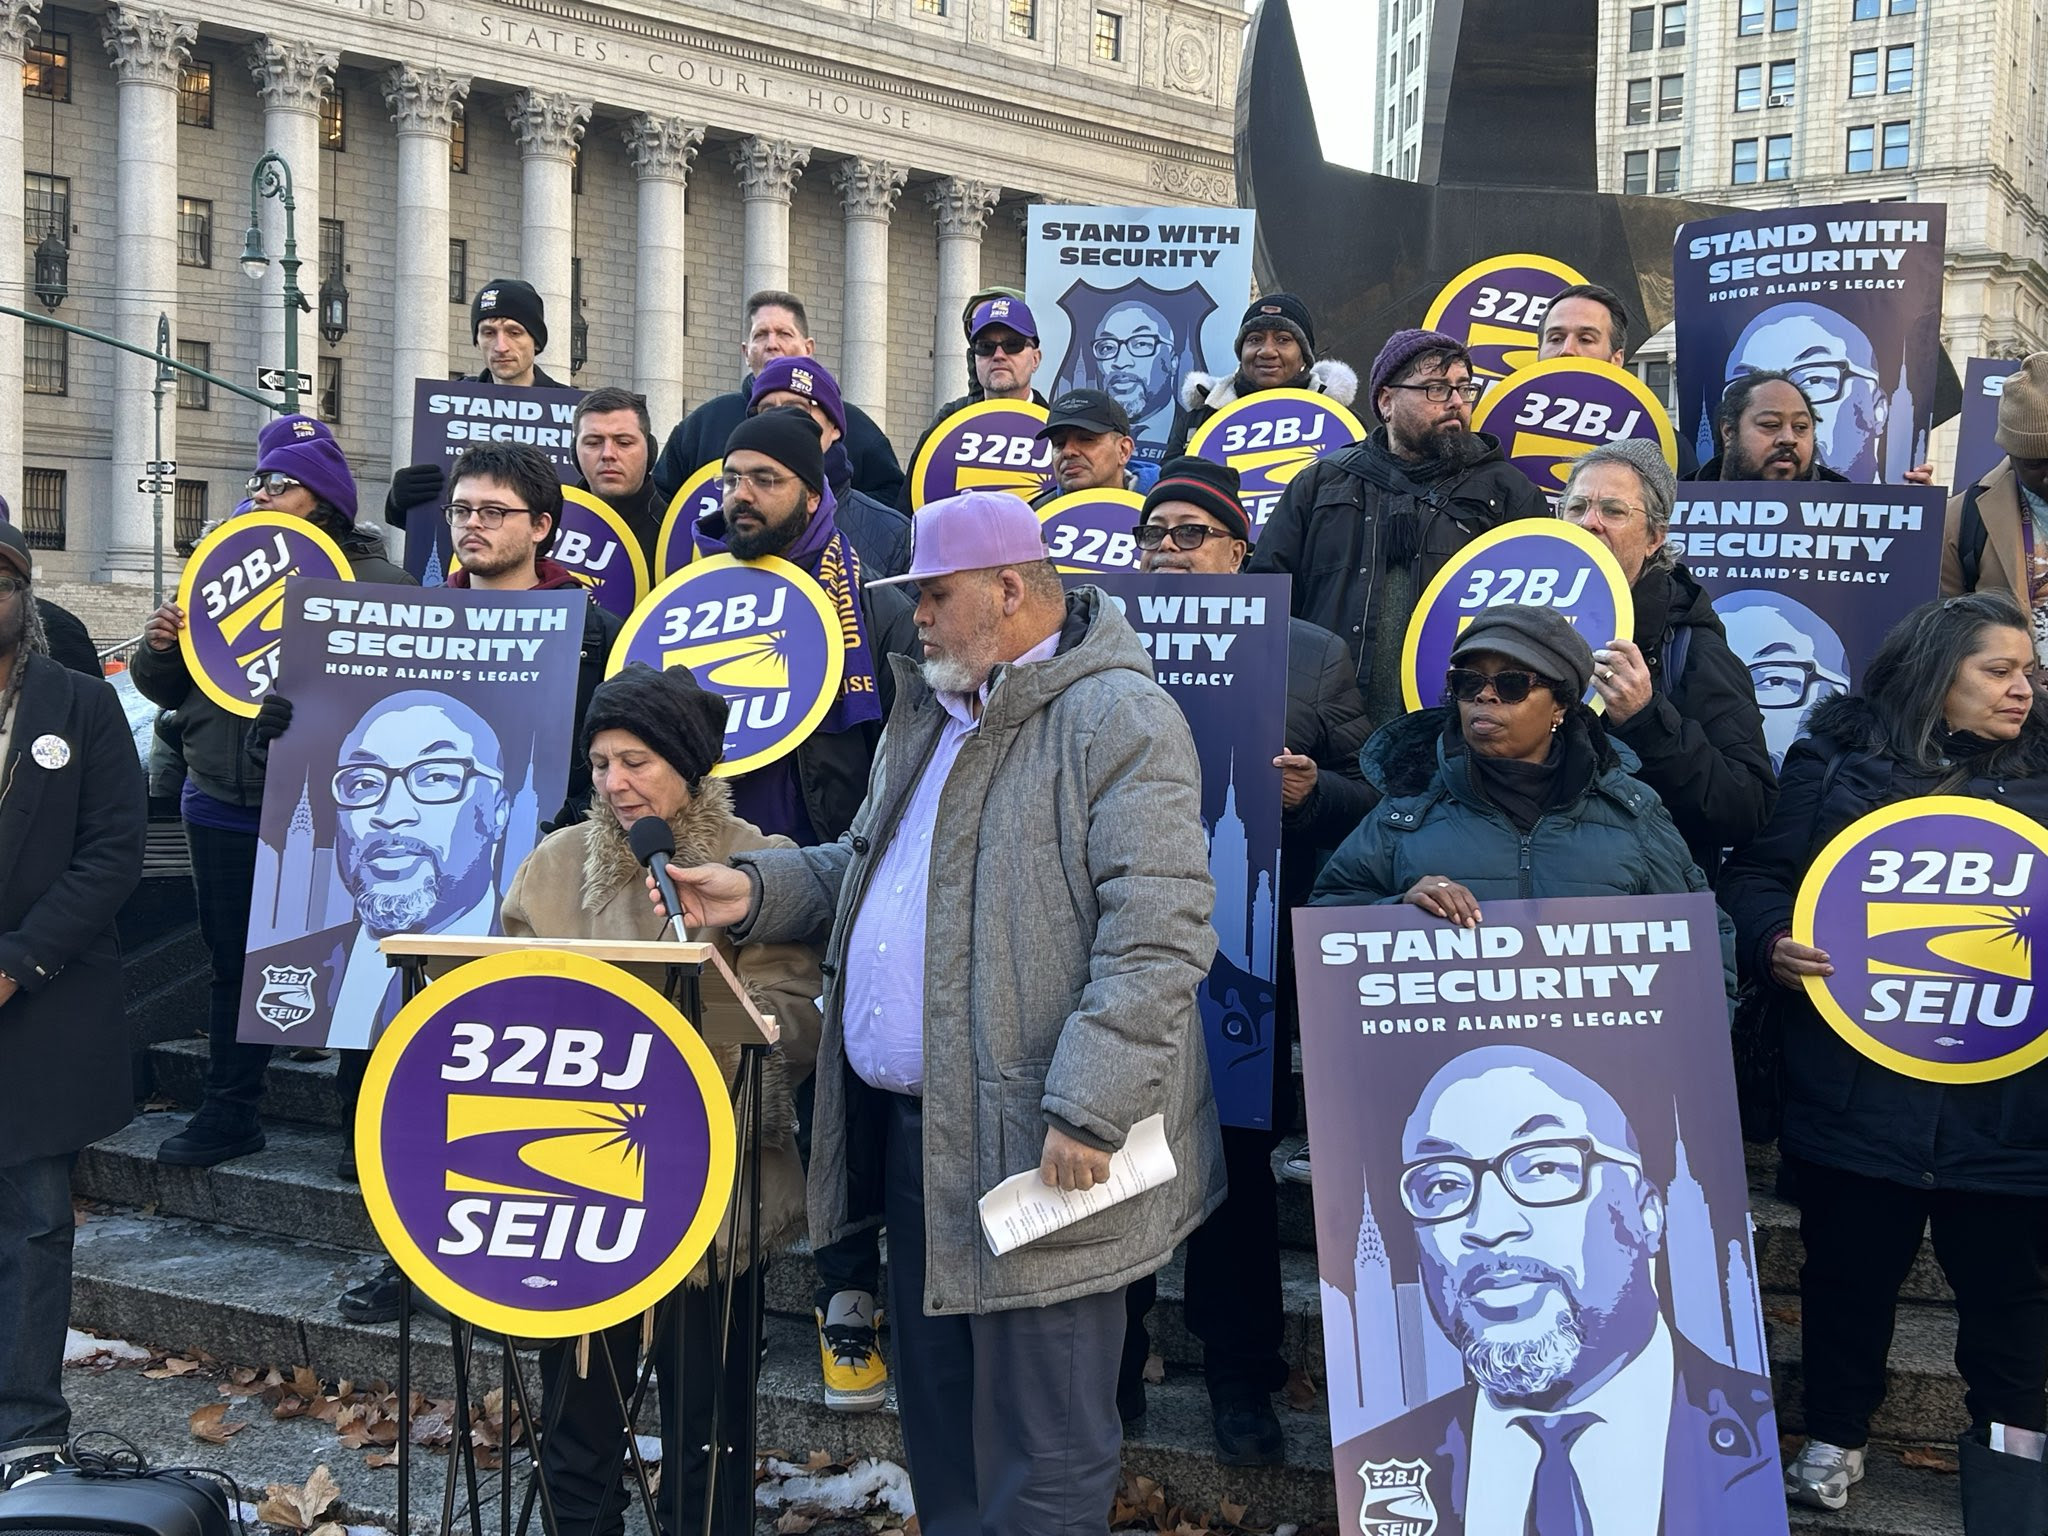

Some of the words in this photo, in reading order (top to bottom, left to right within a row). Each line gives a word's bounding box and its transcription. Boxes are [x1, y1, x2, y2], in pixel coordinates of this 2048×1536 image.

[481, 17, 606, 61] STATES
[649, 54, 773, 99] COURT
[808, 89, 910, 129] HOUSE
[1041, 222, 1150, 243] STAND
[1158, 225, 1240, 245] WITH
[1689, 223, 1817, 259] STAND
[1826, 220, 1929, 243] WITH
[1059, 247, 1221, 268] SECURITY
[1709, 249, 1907, 284] SECURITY
[1469, 287, 1549, 327] 32B
[1709, 286, 1759, 302] HONOR
[1766, 279, 1838, 295] ALAND'S
[1845, 279, 1906, 290] LEGACY
[268, 375, 284, 387] ONE
[297, 380, 307, 389] AY
[429, 394, 543, 421] STAND
[1514, 391, 1641, 441] 32BJ
[1222, 413, 1326, 452] 32BJ
[1668, 501, 1789, 525] TAND
[1800, 502, 1923, 531] WITH
[202, 532, 291, 619] 32BJ
[1459, 568, 1592, 608] 32BJ
[1727, 567, 1809, 580] ALAND'S
[1817, 569, 1890, 584] LEGACY
[303, 597, 455, 629] STAND
[465, 607, 568, 631] WITH
[658, 586, 788, 645] 32BJ
[1138, 596, 1266, 625] WITH
[327, 630, 544, 662] SECURITY
[325, 663, 388, 677] HONOR
[395, 668, 472, 682] ALAND'S
[478, 670, 540, 682] LEGACY
[1158, 672, 1234, 686] LEGACY
[1861, 850, 2034, 897] 32BJ
[1320, 926, 1524, 965] STAND
[1536, 920, 1691, 957] WITH
[270, 973, 308, 984] 32BJ
[1358, 964, 1660, 1006] SECURITY
[267, 1008, 303, 1019] SEIU
[1864, 979, 2035, 1027] SEIU
[1361, 1017, 1447, 1034] HONOR
[1457, 1013, 1563, 1031] ALAND'S
[1573, 1010, 1664, 1027] LEGACY
[440, 1022, 654, 1091] 32BJ
[437, 1199, 647, 1263] SEIU
[1371, 1469, 1419, 1486] 32BJ
[1377, 1523, 1423, 1536] SEIU
